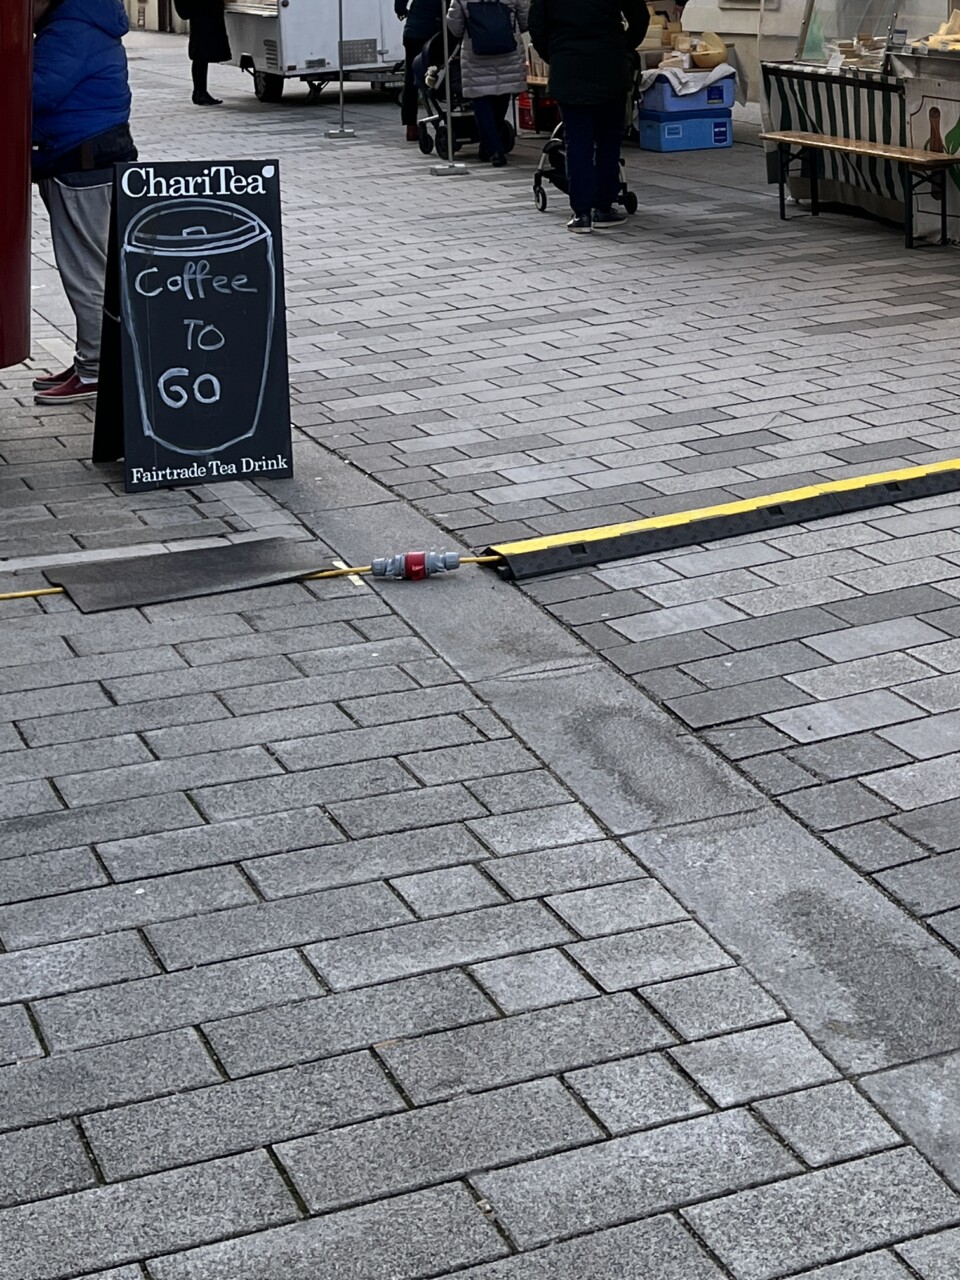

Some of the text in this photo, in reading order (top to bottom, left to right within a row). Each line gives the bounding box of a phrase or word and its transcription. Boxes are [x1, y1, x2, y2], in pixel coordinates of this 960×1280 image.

[121, 166, 266, 198] ChariTea
[134, 260, 258, 301] Coffee
[183, 319, 225, 351] TO
[157, 367, 221, 409] GO
[131, 455, 288, 484] Fairtrade Tea Drink
